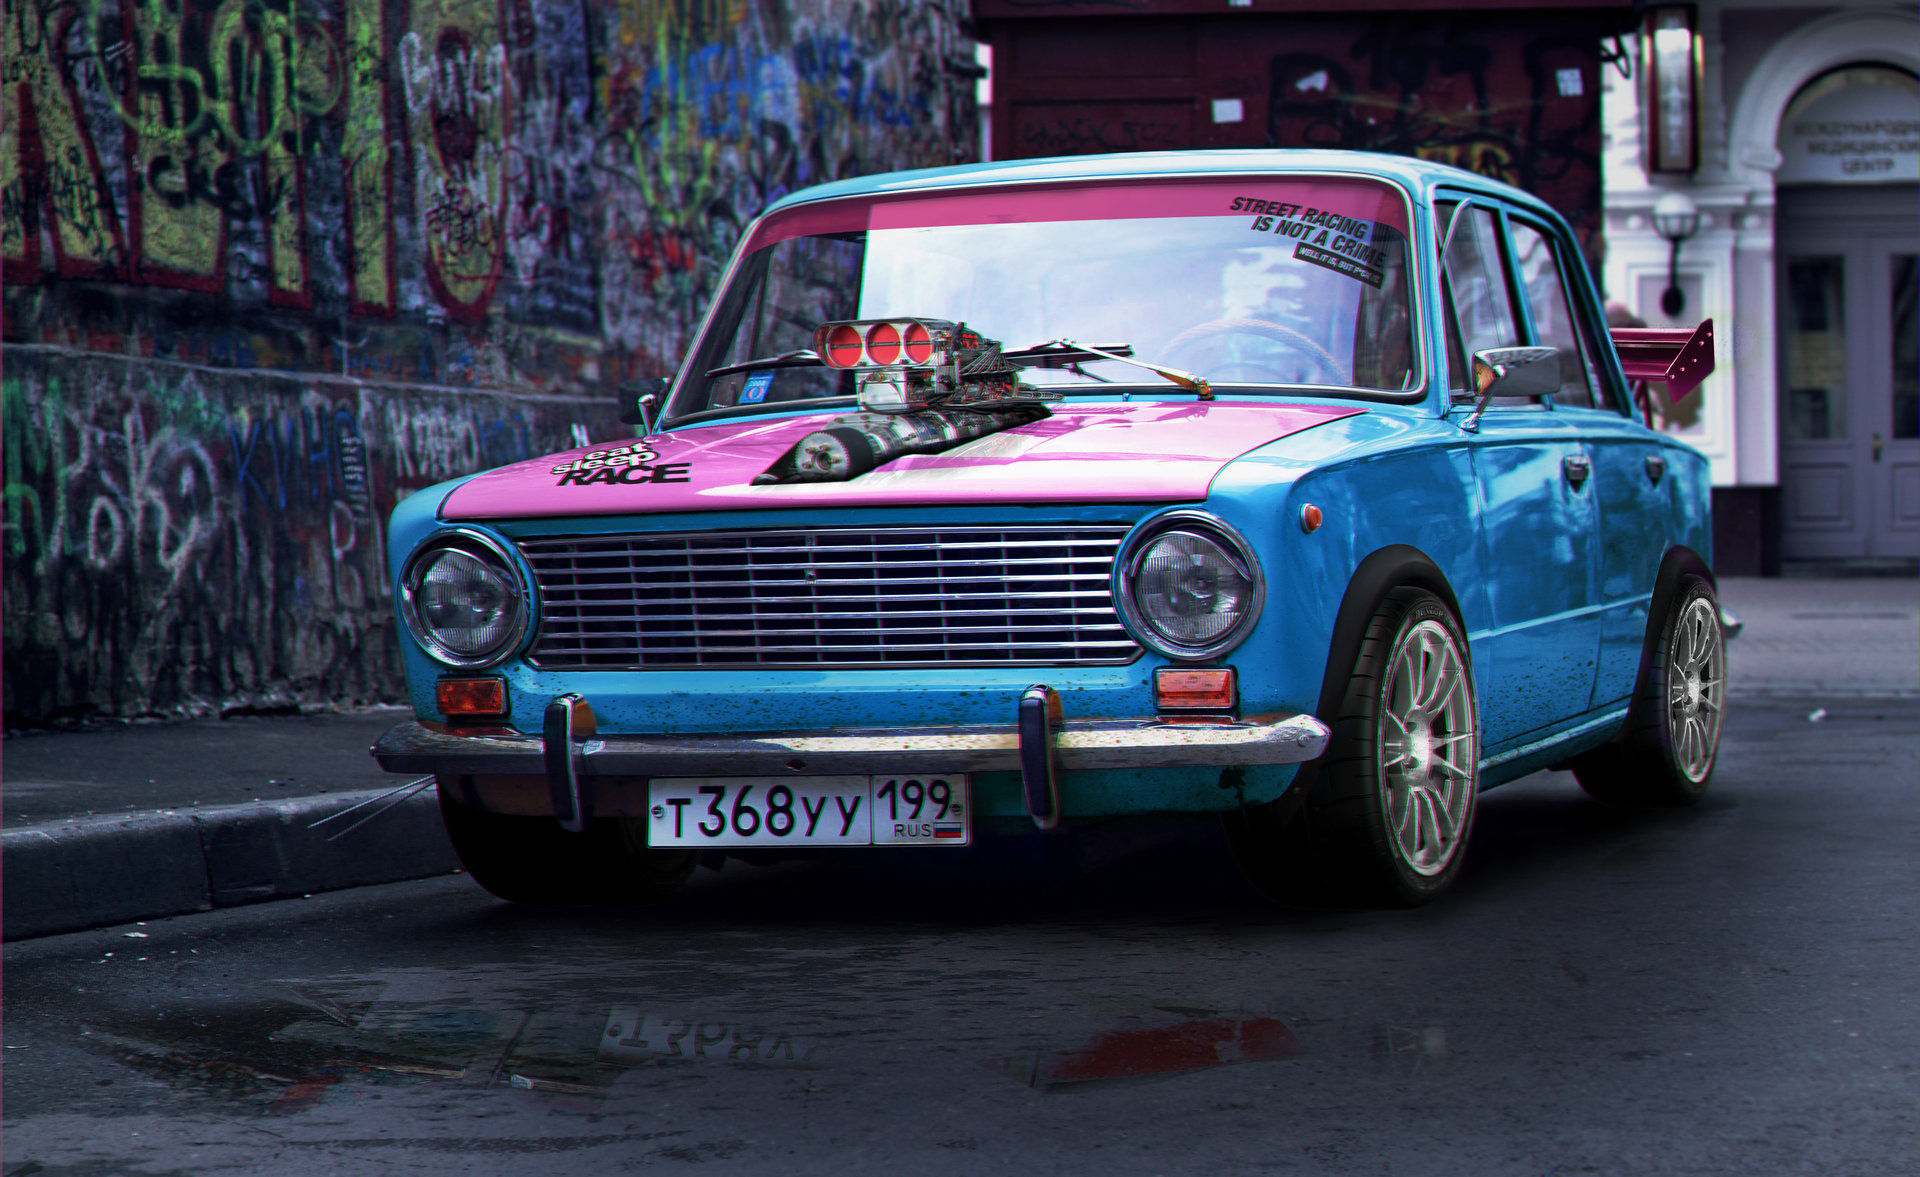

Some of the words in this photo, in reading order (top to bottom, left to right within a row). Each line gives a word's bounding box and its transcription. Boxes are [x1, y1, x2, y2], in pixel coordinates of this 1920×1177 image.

[1229, 196, 1303, 219] STREET
[1300, 207, 1369, 240] RACING
[1251, 215, 1275, 232] IS
[1274, 219, 1316, 241] NOT
[1312, 230, 1331, 247] A
[1331, 235, 1387, 270] CRIME
[551, 451, 661, 474] sleep
[584, 441, 653, 461] eat
[556, 462, 692, 486] RACE
[876, 779, 953, 820] 199
[894, 823, 933, 838] RUS
